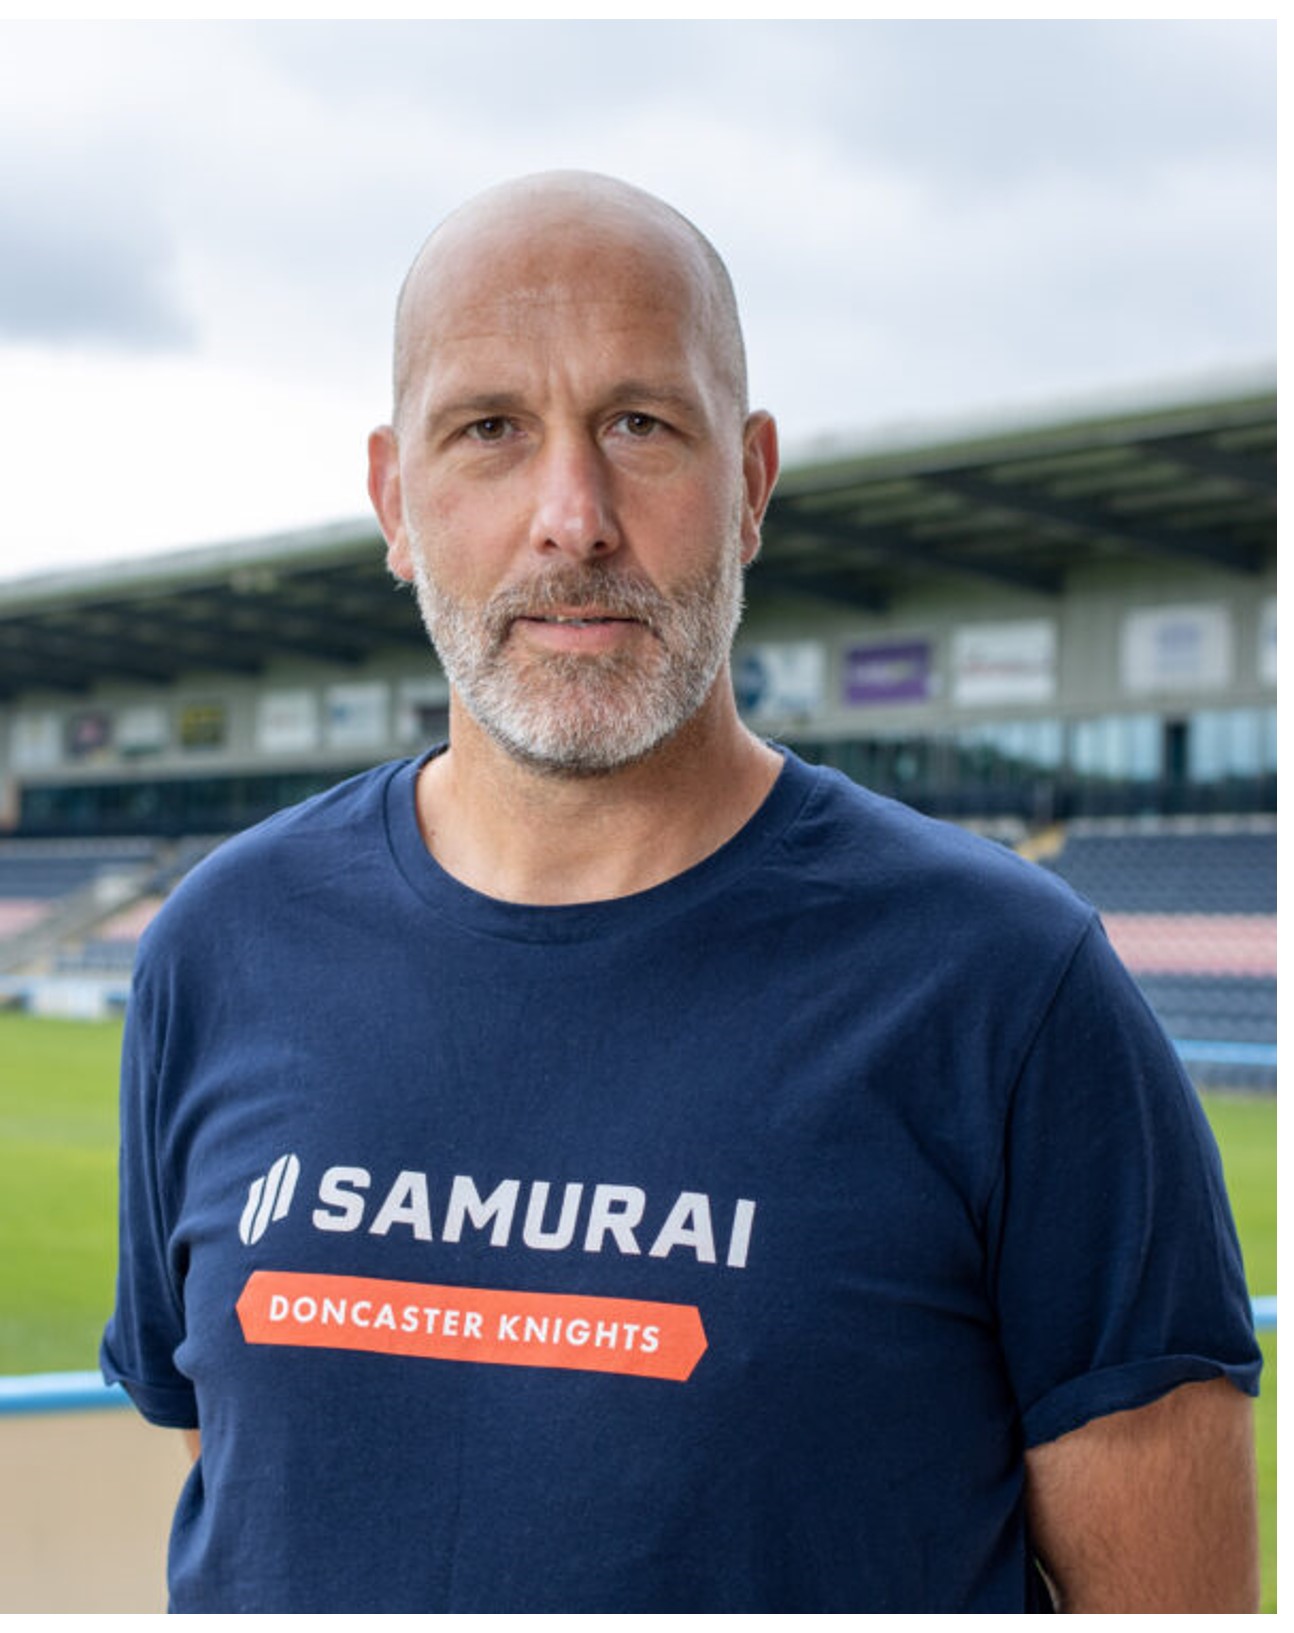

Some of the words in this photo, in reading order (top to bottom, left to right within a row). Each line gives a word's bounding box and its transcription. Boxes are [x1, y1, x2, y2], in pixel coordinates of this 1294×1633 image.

[312, 1165, 757, 1268] SAMURAI
[268, 1294, 483, 1340] DONCASTER
[498, 1315, 661, 1354] KNIGHTS
